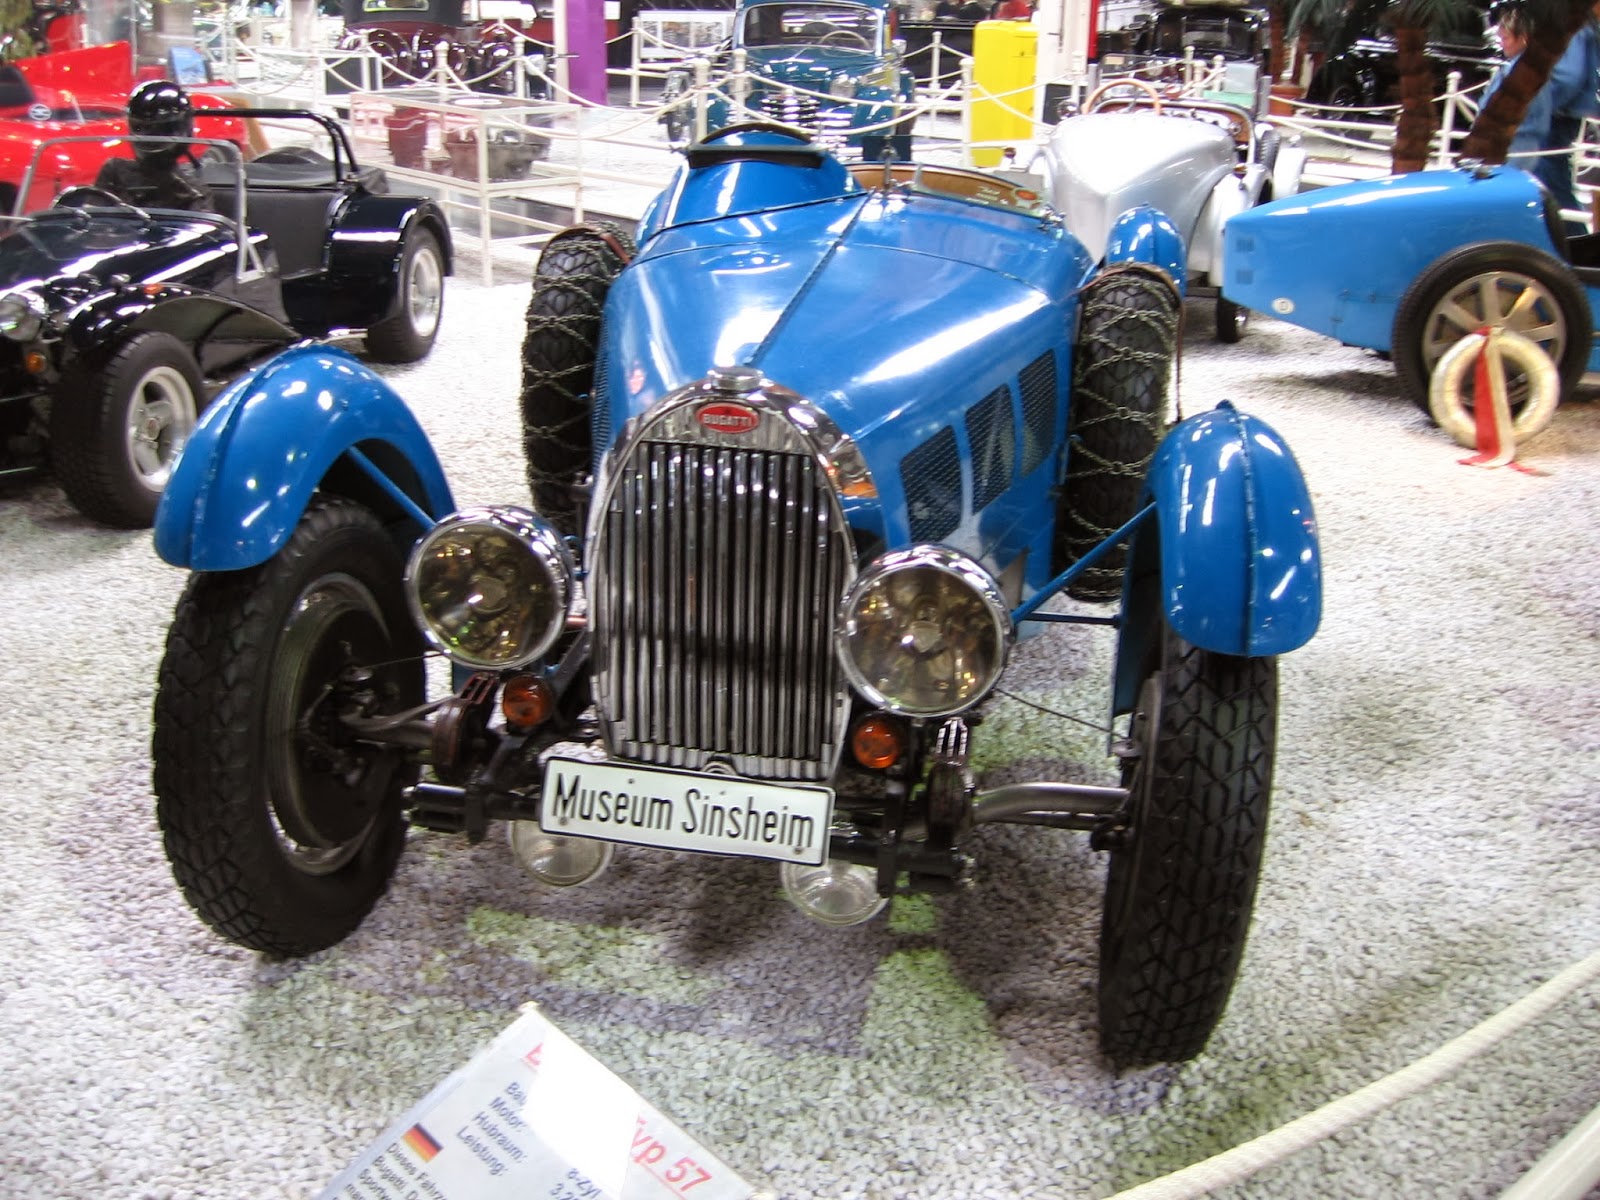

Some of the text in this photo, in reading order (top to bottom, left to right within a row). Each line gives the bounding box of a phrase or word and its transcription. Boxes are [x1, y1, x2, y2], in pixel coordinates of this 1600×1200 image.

[552, 772, 814, 848] Museum Sinsheim
[472, 1111, 528, 1163] Hubraum:
[489, 1097, 526, 1132] Motor:
[386, 1142, 417, 1175] Dieses
[456, 1125, 508, 1176] Leistung:
[632, 1115, 712, 1192] yp 57
